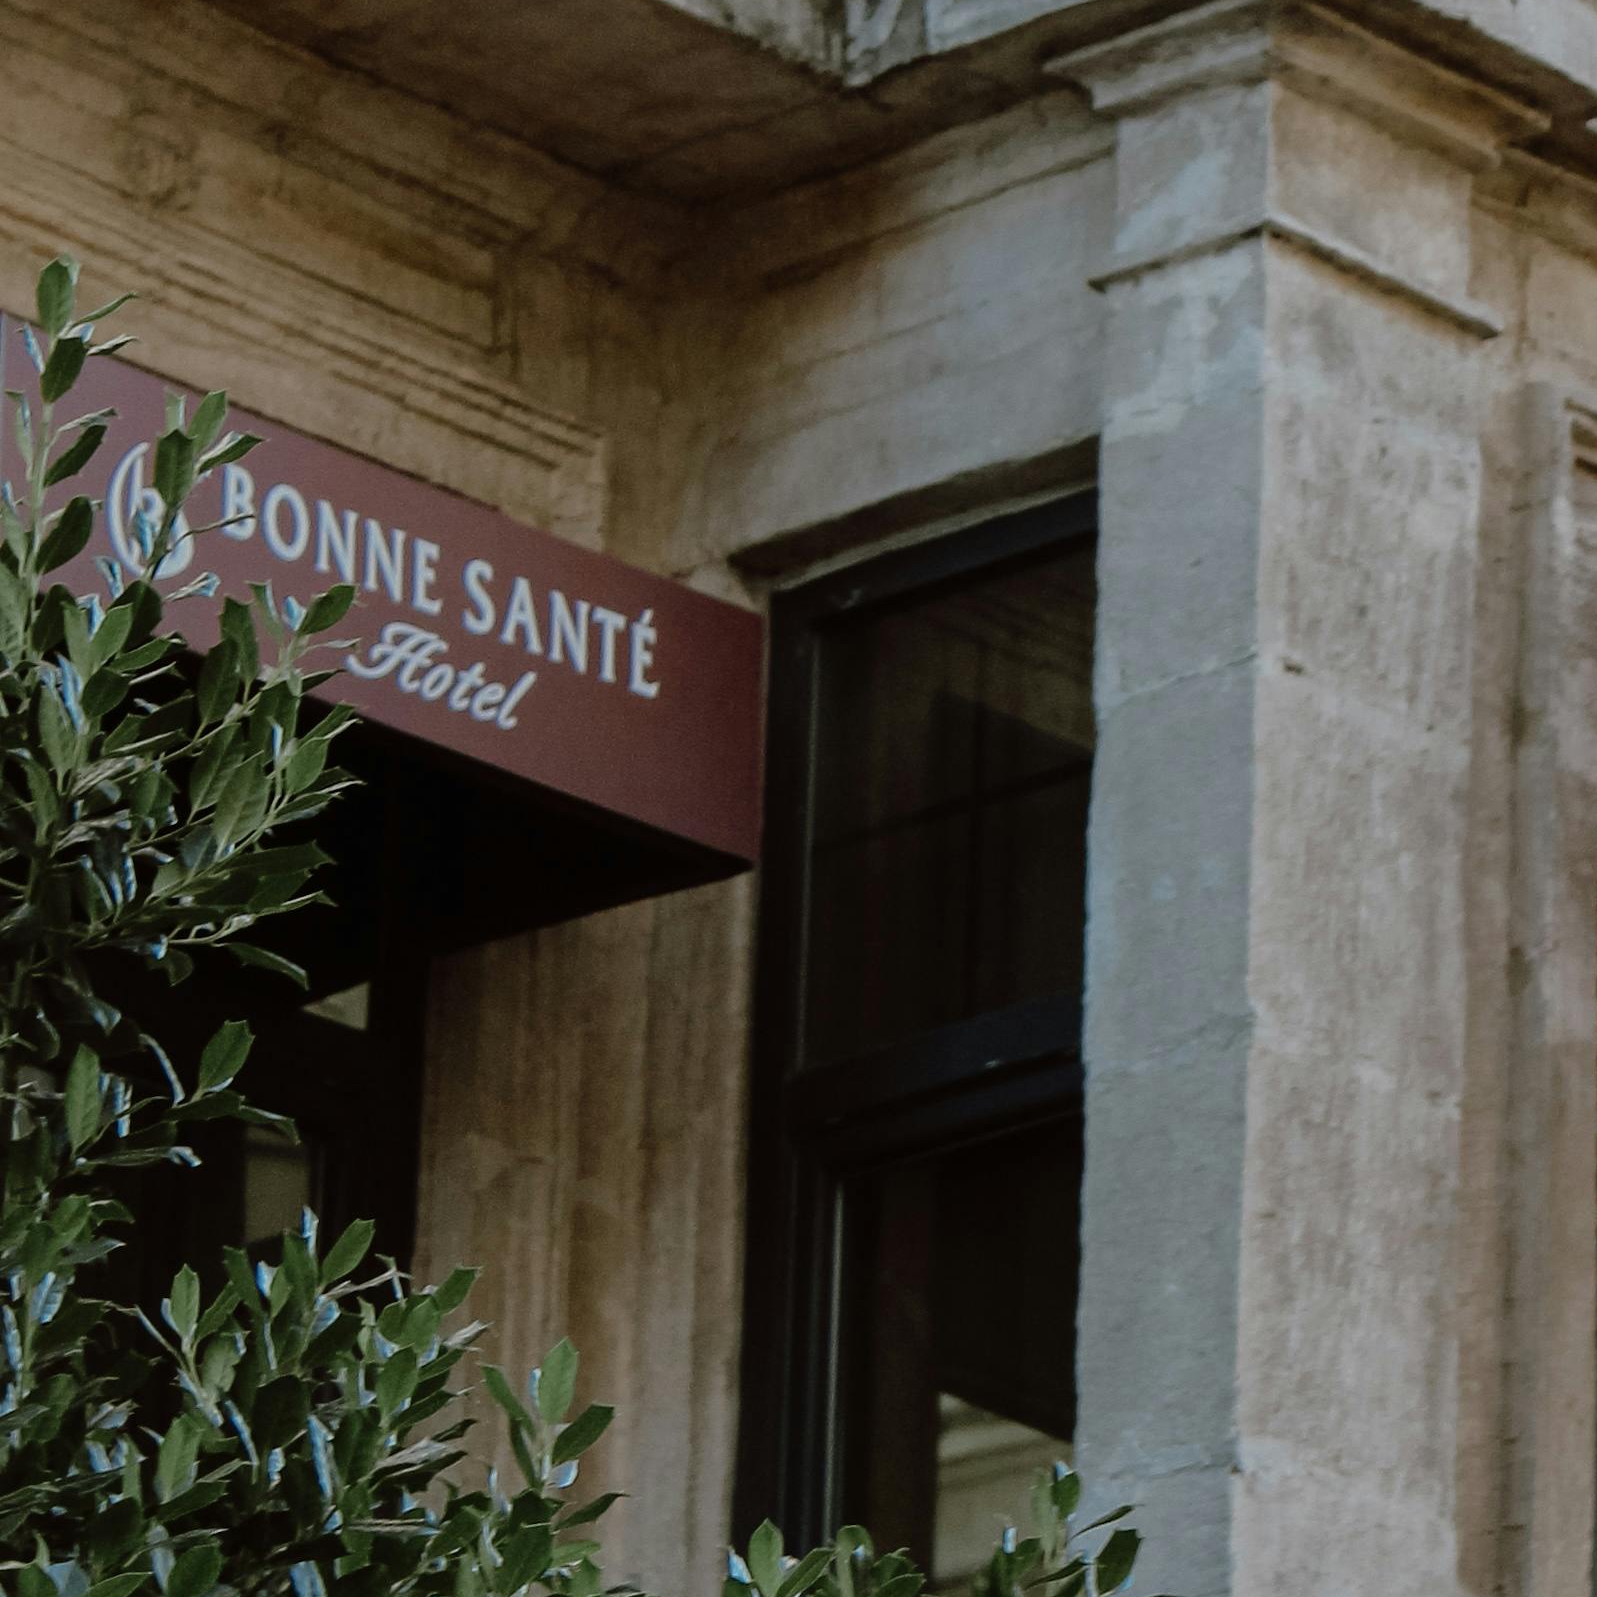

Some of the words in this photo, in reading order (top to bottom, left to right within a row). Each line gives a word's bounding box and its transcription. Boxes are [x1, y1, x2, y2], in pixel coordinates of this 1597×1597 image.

[222, 462, 442, 617] BONNE
[462, 557, 661, 699] SANTÉ
[344, 621, 538, 731] Hotel
